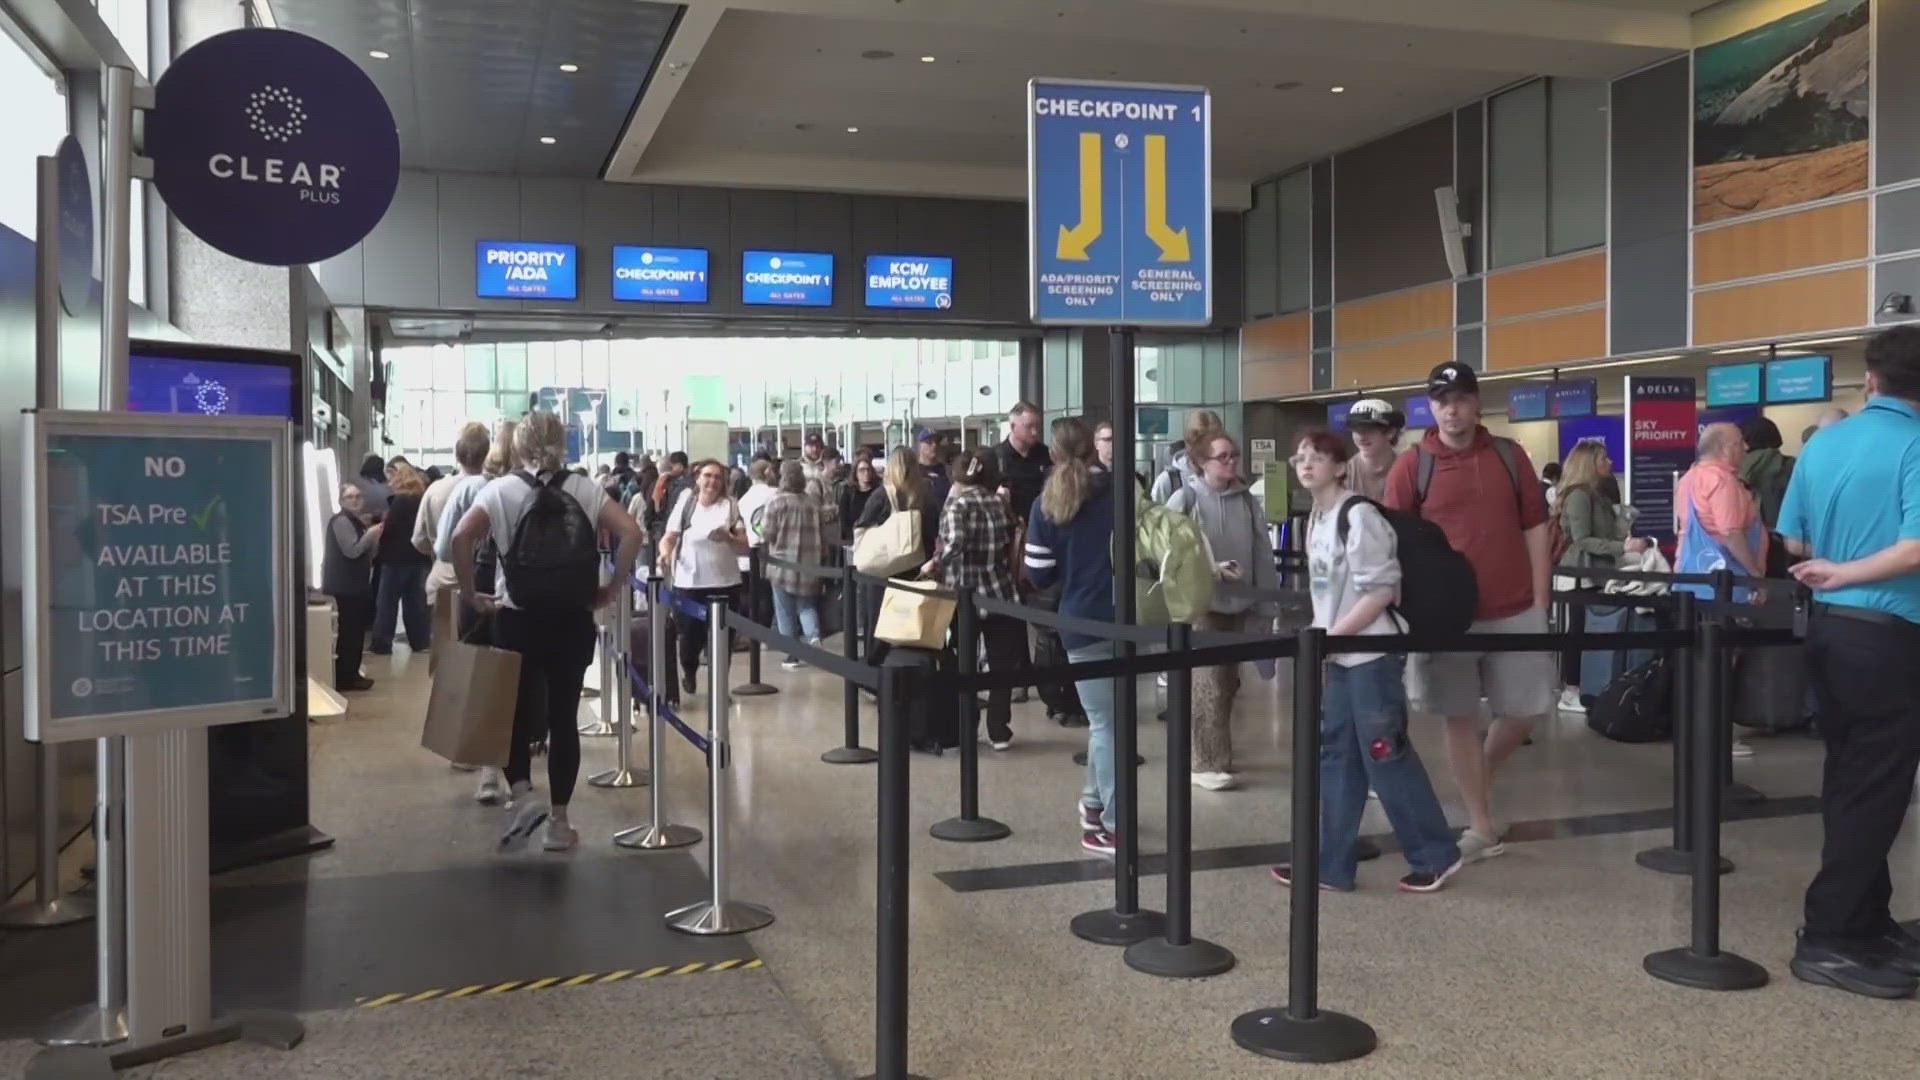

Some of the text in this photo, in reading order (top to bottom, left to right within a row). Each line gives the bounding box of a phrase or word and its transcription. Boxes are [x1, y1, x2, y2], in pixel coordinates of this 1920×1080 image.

[1036, 98, 1201, 122] CHECKPOINT 1
[208, 153, 341, 188] CLEAR
[300, 189, 341, 205] PLUS
[487, 249, 566, 267] PRIORITY
[505, 266, 548, 281] /ADA
[616, 267, 704, 282] CHECKPOINT 1
[890, 262, 928, 276] KCM/
[1138, 269, 1195, 280] GENERAL
[745, 272, 829, 286] CHECKPOINT 1
[869, 276, 948, 290] EMPLOYEE
[1040, 273, 1120, 284] ADA/PRIORITY
[1131, 280, 1202, 291] SCREENING
[1048, 285, 1113, 295] SCREENING
[1150, 291, 1184, 302] ONLY
[1065, 296, 1096, 306] ONLY
[1647, 385, 1680, 395] DELTA
[1634, 420, 1657, 431] SKY
[1634, 431, 1687, 441] PRIORITY
[144, 456, 186, 478] NO
[96, 504, 187, 525] TSA Pre
[97, 542, 232, 567] AVAILABLE
[115, 574, 217, 599] AT THIS
[79, 603, 249, 632] LOCATION AT
[99, 634, 232, 662] THIS TIME
